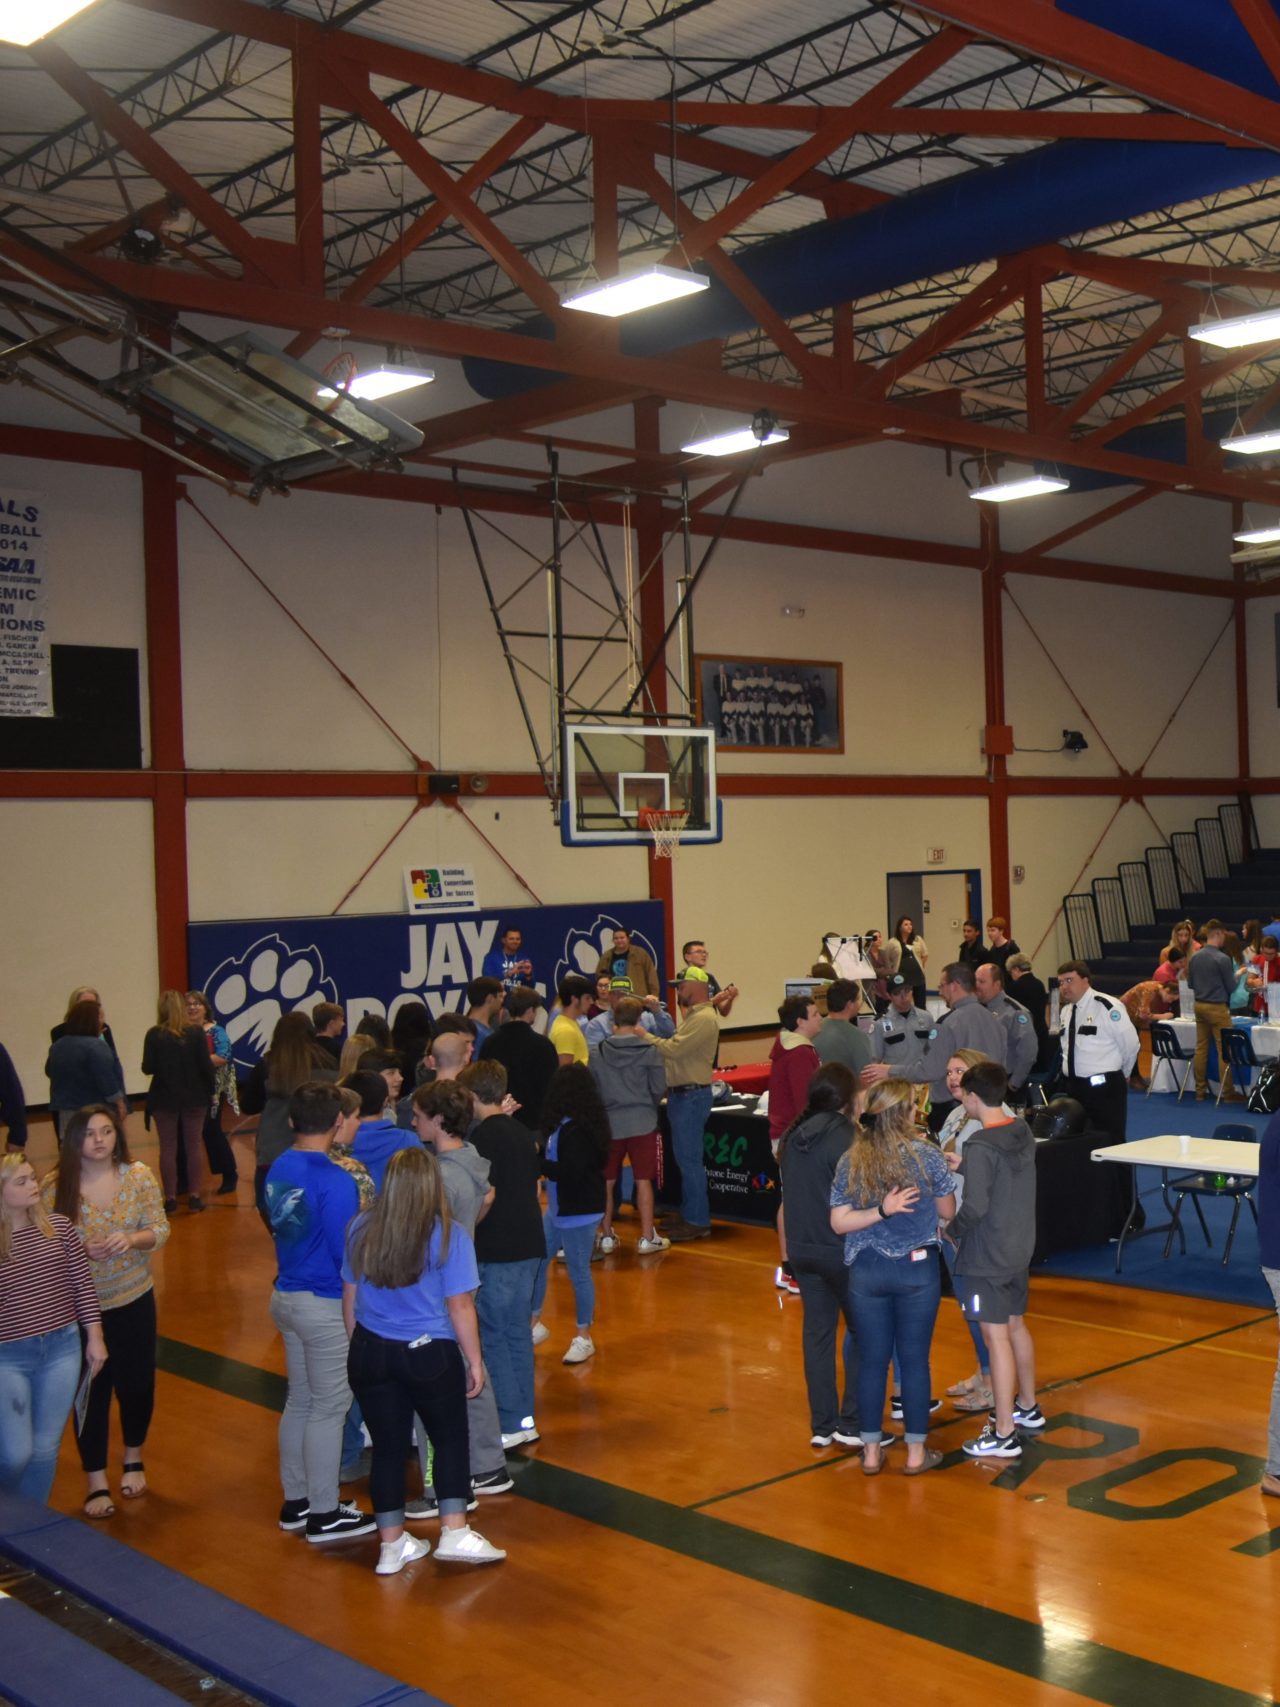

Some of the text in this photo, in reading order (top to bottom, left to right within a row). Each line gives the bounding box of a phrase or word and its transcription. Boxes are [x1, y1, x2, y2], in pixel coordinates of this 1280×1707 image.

[0, 524, 42, 537] BALL
[0, 539, 28, 551] 014
[0, 557, 35, 574] SAA
[0, 618, 45, 632] IONS
[400, 919, 499, 989] JAY
[704, 1132, 748, 1167] REC
[709, 1180, 748, 1194] Cooperative
